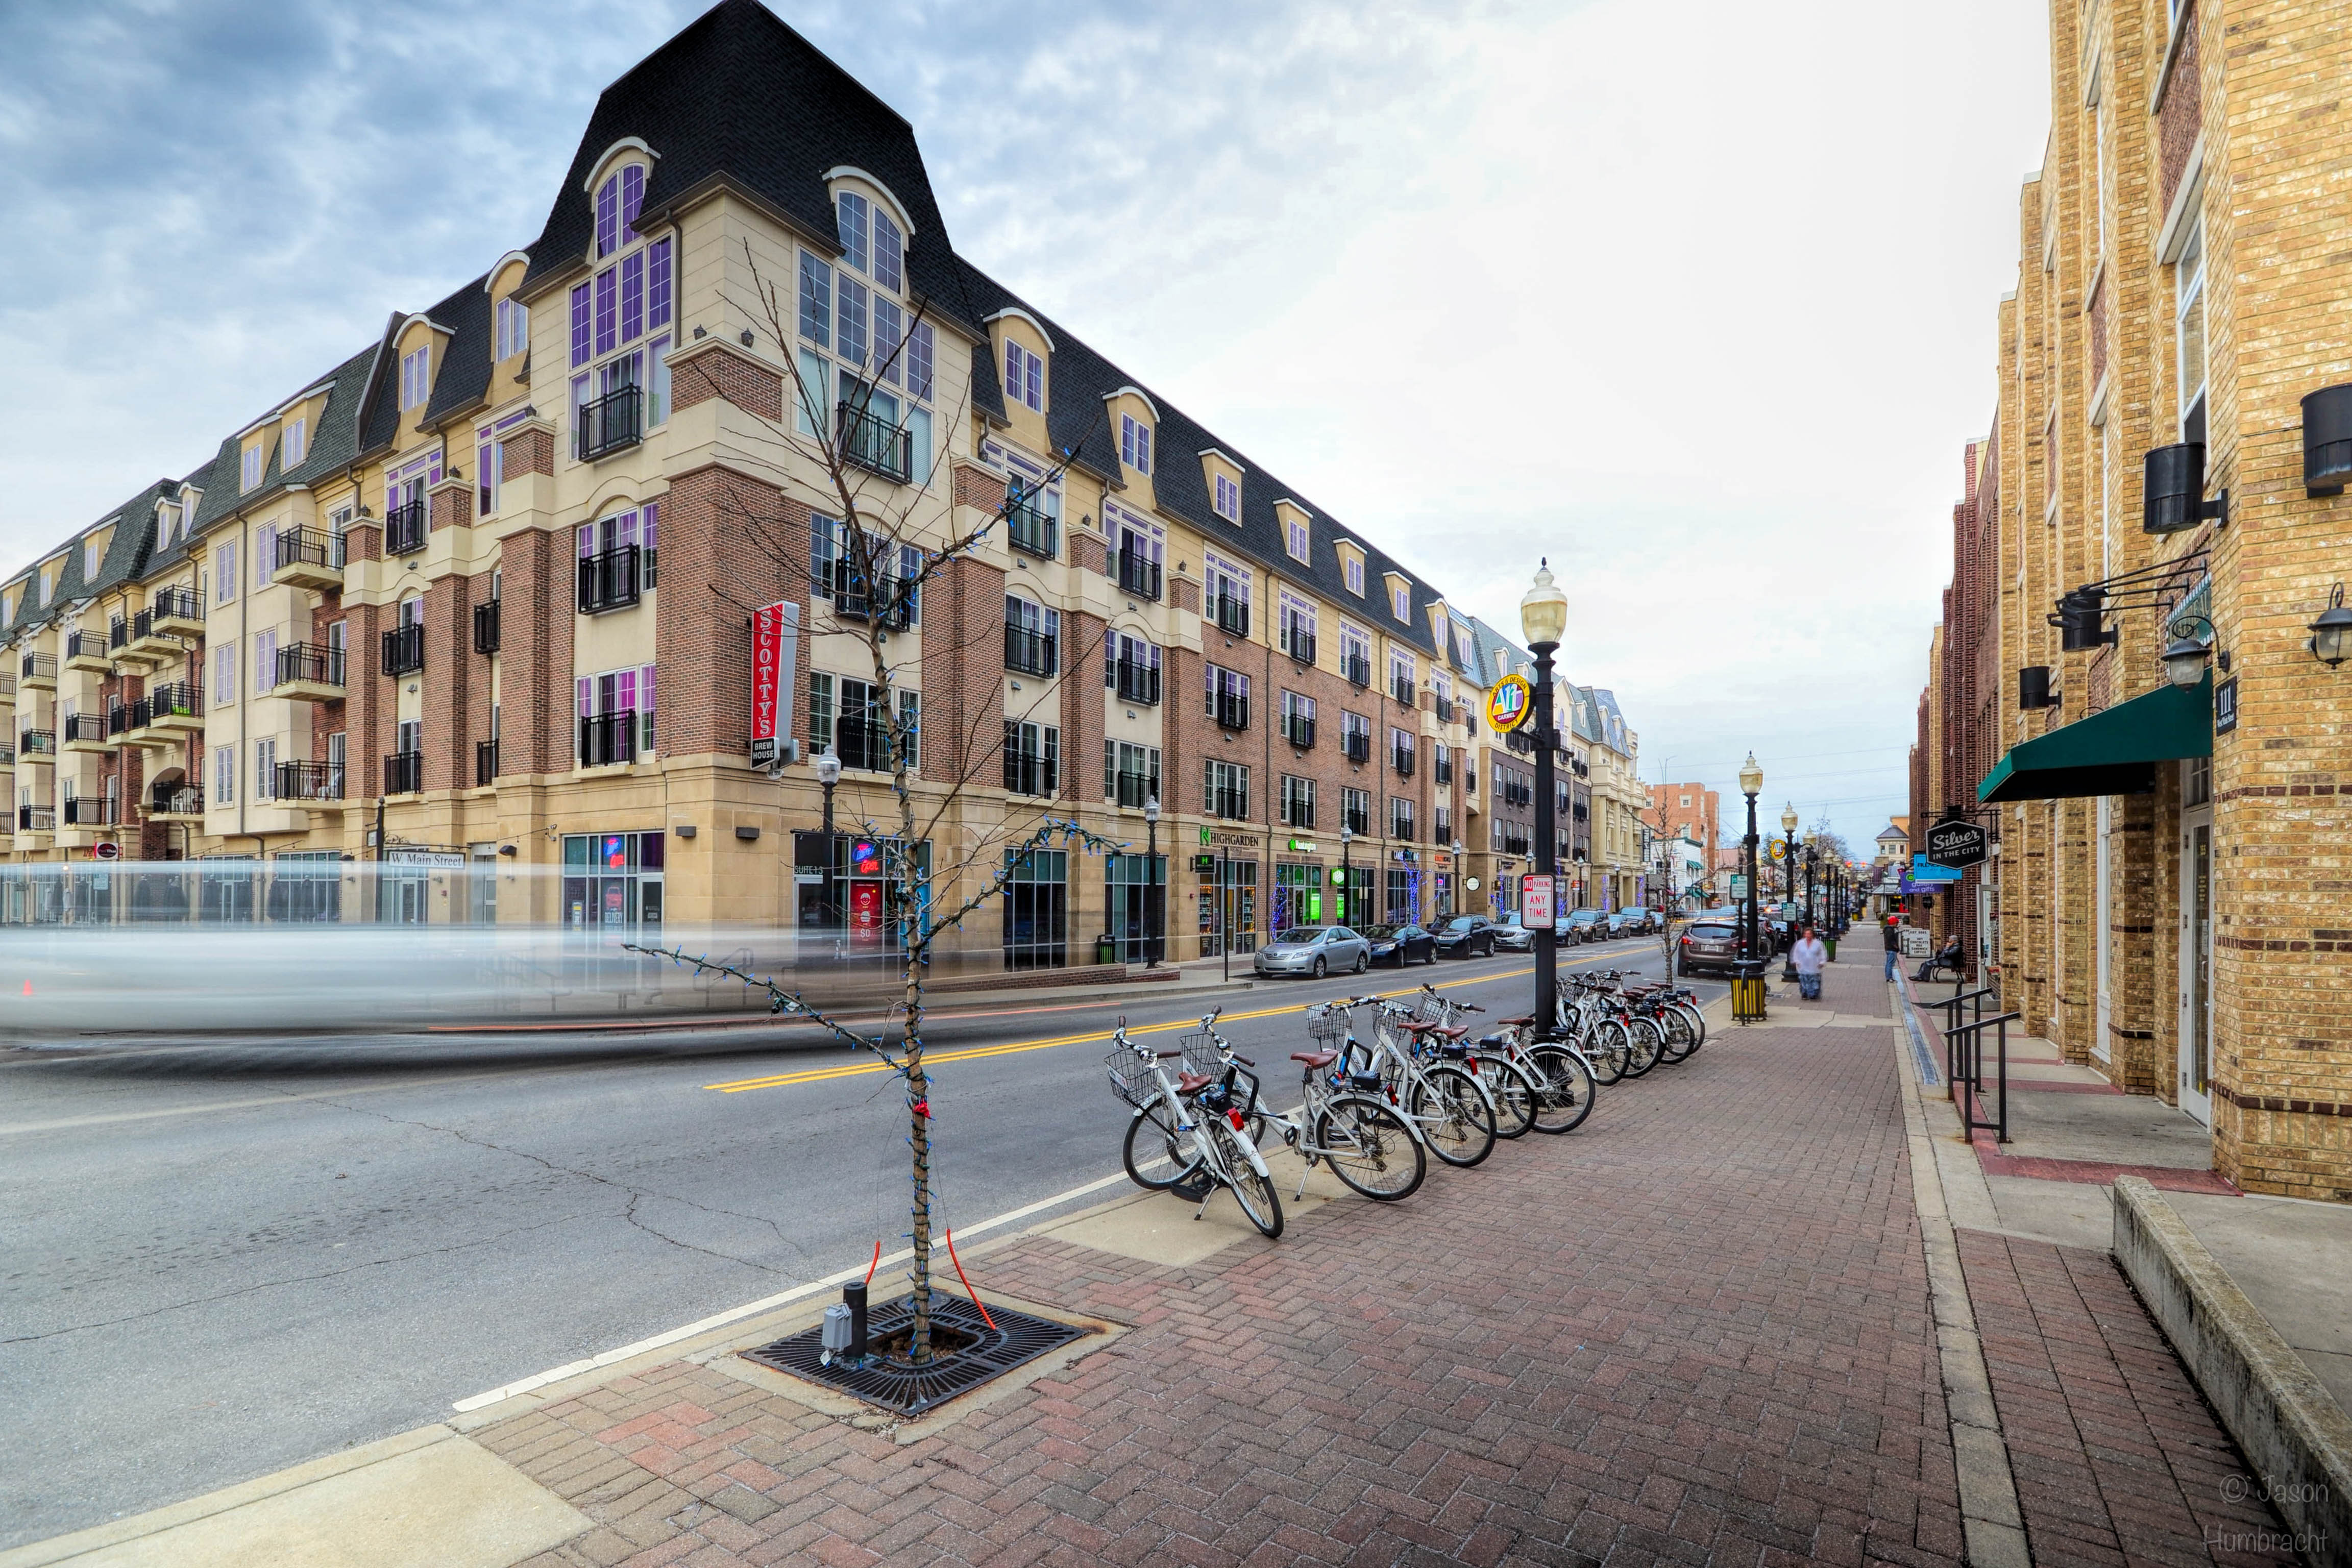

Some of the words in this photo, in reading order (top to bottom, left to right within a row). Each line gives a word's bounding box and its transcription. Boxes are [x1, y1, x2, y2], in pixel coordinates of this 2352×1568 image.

[758, 610, 773, 736] SCOTTY'S
[1492, 680, 1505, 697] ARTS
[1510, 677, 1527, 690] DESIGN
[2220, 686, 2231, 716] 111
[1494, 719, 1518, 730] DISTRICT
[754, 742, 772, 750] BREW
[753, 750, 774, 760] HOUSE
[1211, 832, 1258, 846] HIGHGARDEN
[1933, 830, 1980, 850] Silver
[1962, 846, 1980, 854] CITY
[391, 853, 403, 865] W.
[407, 853, 431, 865] Main
[434, 855, 461, 866] Street
[795, 866, 813, 874] SUITE
[1525, 879, 1532, 889] NO
[1530, 895, 1546, 904] ANY
[605, 912, 623, 923] DELIVERY
[1529, 909, 1547, 918] TIME
